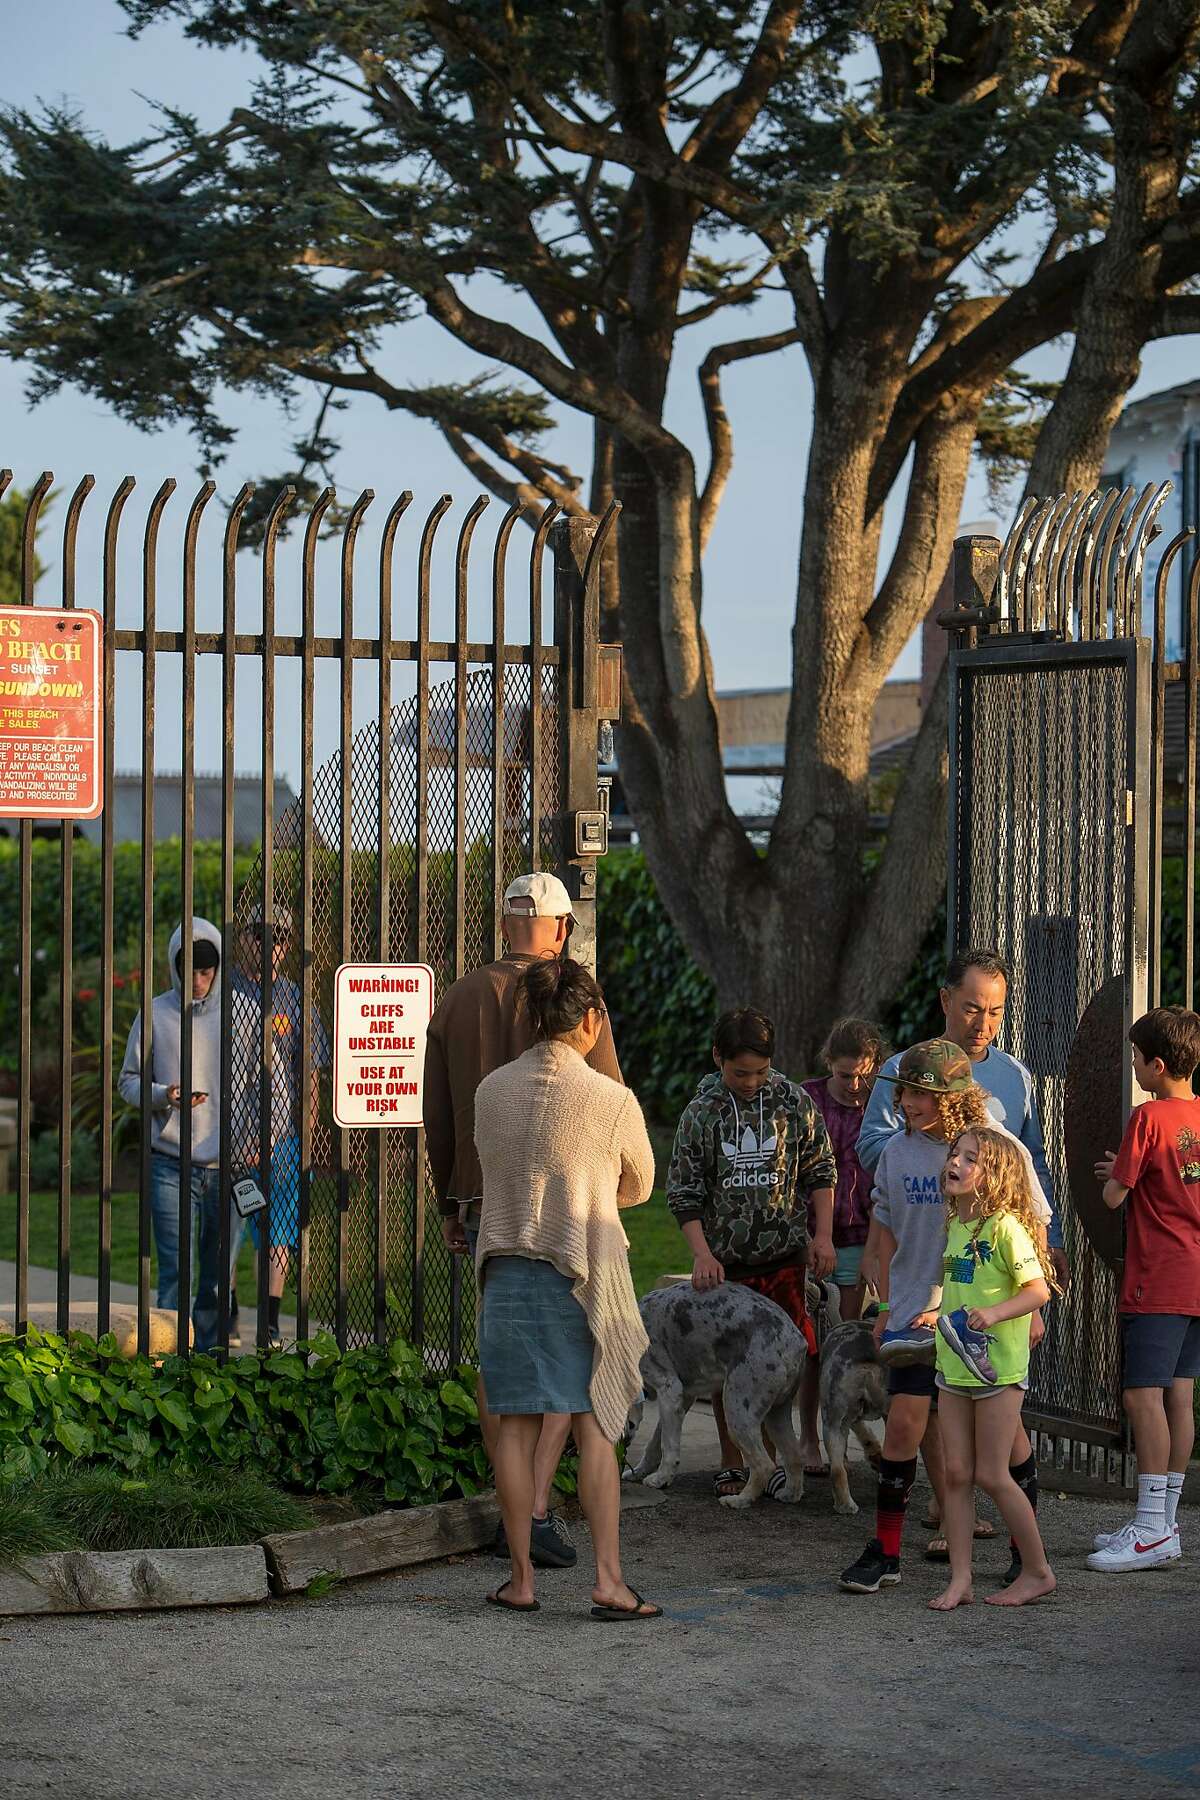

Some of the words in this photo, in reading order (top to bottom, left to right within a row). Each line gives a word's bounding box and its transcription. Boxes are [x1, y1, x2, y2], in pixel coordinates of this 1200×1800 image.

[7, 640, 82, 661] BEACH
[10, 663, 59, 675] SUNSET
[3, 708, 23, 718] THIS
[28, 709, 58, 719] BEACH
[8, 720, 41, 729] SALES.
[14, 743, 30, 751] OUR
[32, 743, 57, 752] BEACH
[60, 744, 83, 752] CLEAN
[14, 753, 41, 761] PLEASE
[44, 753, 62, 762] CALL
[65, 754, 76, 762] 911
[10, 762, 24, 770] ANY
[27, 762, 67, 771] VANDALISM
[69, 763, 80, 771] OR
[4, 771, 38, 780] ACTIVITY.
[44, 772, 87, 782] INDIVIDUALS
[49, 782, 65, 791] WILL
[68, 783, 78, 791] BE
[9, 790, 25, 799] AND
[348, 979, 419, 993] WARNING!
[360, 1004, 404, 1017] CLIFFS
[369, 1020, 395, 1034] ARE
[348, 1036, 416, 1050] UNSTABLE
[360, 1066, 386, 1079] USE
[388, 1066, 405, 1079] AT
[346, 1082, 382, 1096] YOUR
[385, 1082, 418, 1096] OWN
[366, 1099, 398, 1112] RISK
[722, 1170, 779, 1189] adidas
[906, 1193, 944, 1205] EWMA
